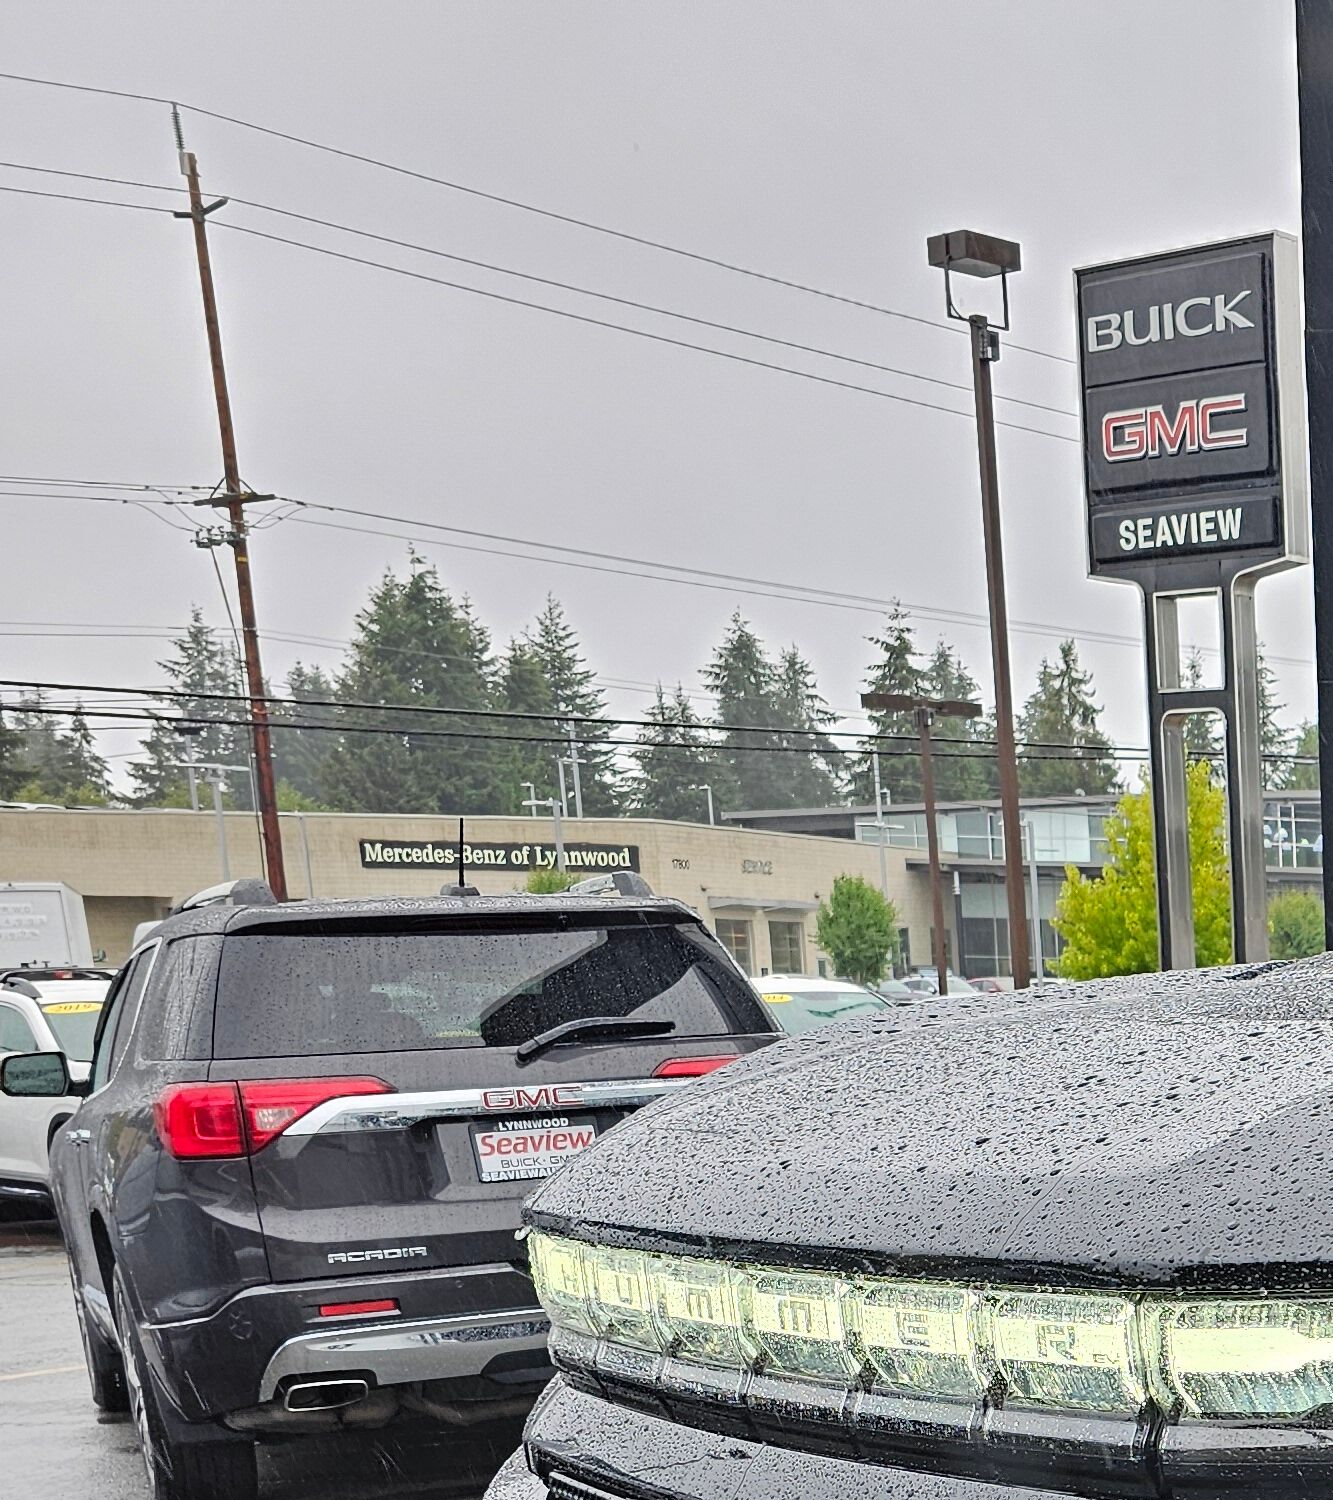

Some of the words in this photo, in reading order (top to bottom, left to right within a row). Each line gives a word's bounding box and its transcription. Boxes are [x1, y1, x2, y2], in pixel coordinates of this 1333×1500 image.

[1087, 290, 1255, 353] BUICK
[1102, 393, 1248, 463] GMC
[1119, 508, 1242, 551] SEAVIEW
[363, 842, 507, 866] Mercedes-Benz
[511, 846, 529, 865] of
[481, 1083, 584, 1110] GMC
[498, 1117, 569, 1131] LYNNWOOD
[480, 1130, 593, 1157] Seaview
[501, 1156, 543, 1169] BUICK
[327, 1246, 428, 1264] ACADIA
